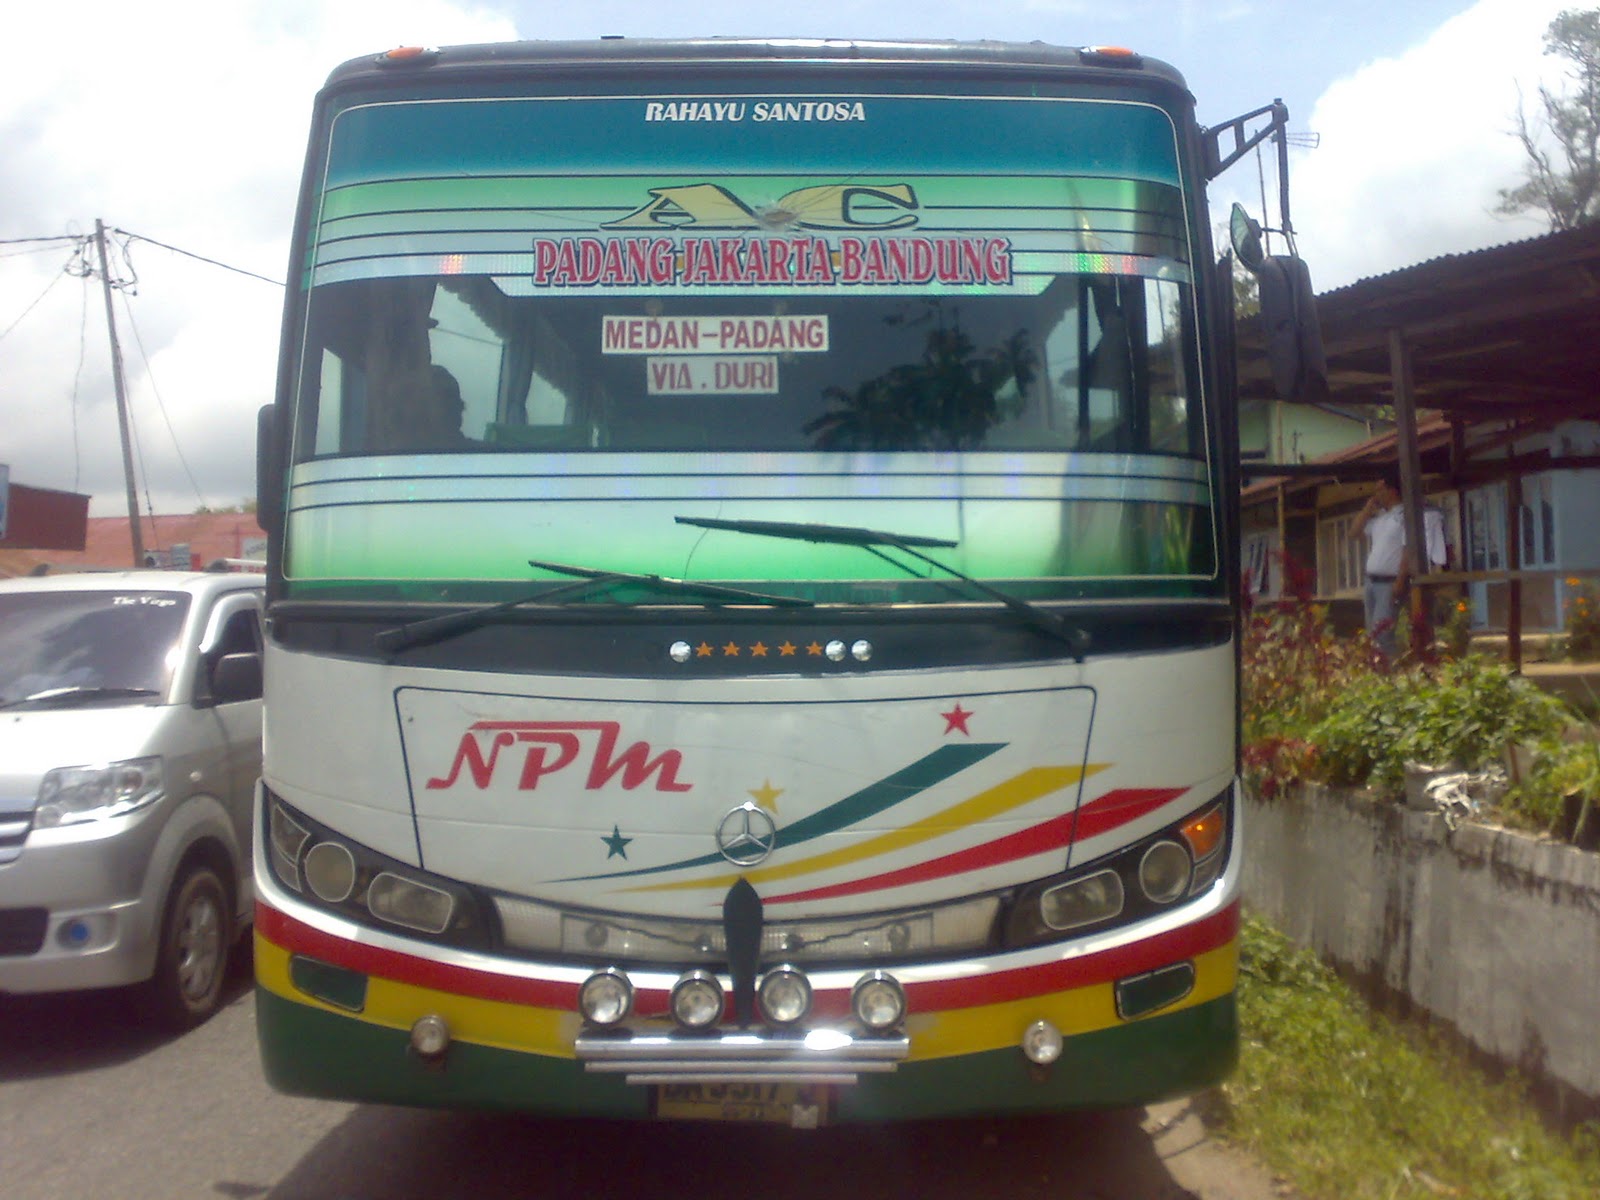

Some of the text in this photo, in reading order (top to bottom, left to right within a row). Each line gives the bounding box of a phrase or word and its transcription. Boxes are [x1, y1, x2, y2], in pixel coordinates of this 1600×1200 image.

[645, 102, 865, 121] RAHAYU SANTOSA
[533, 237, 1012, 286] PADANG JAKARTA BANDUNG
